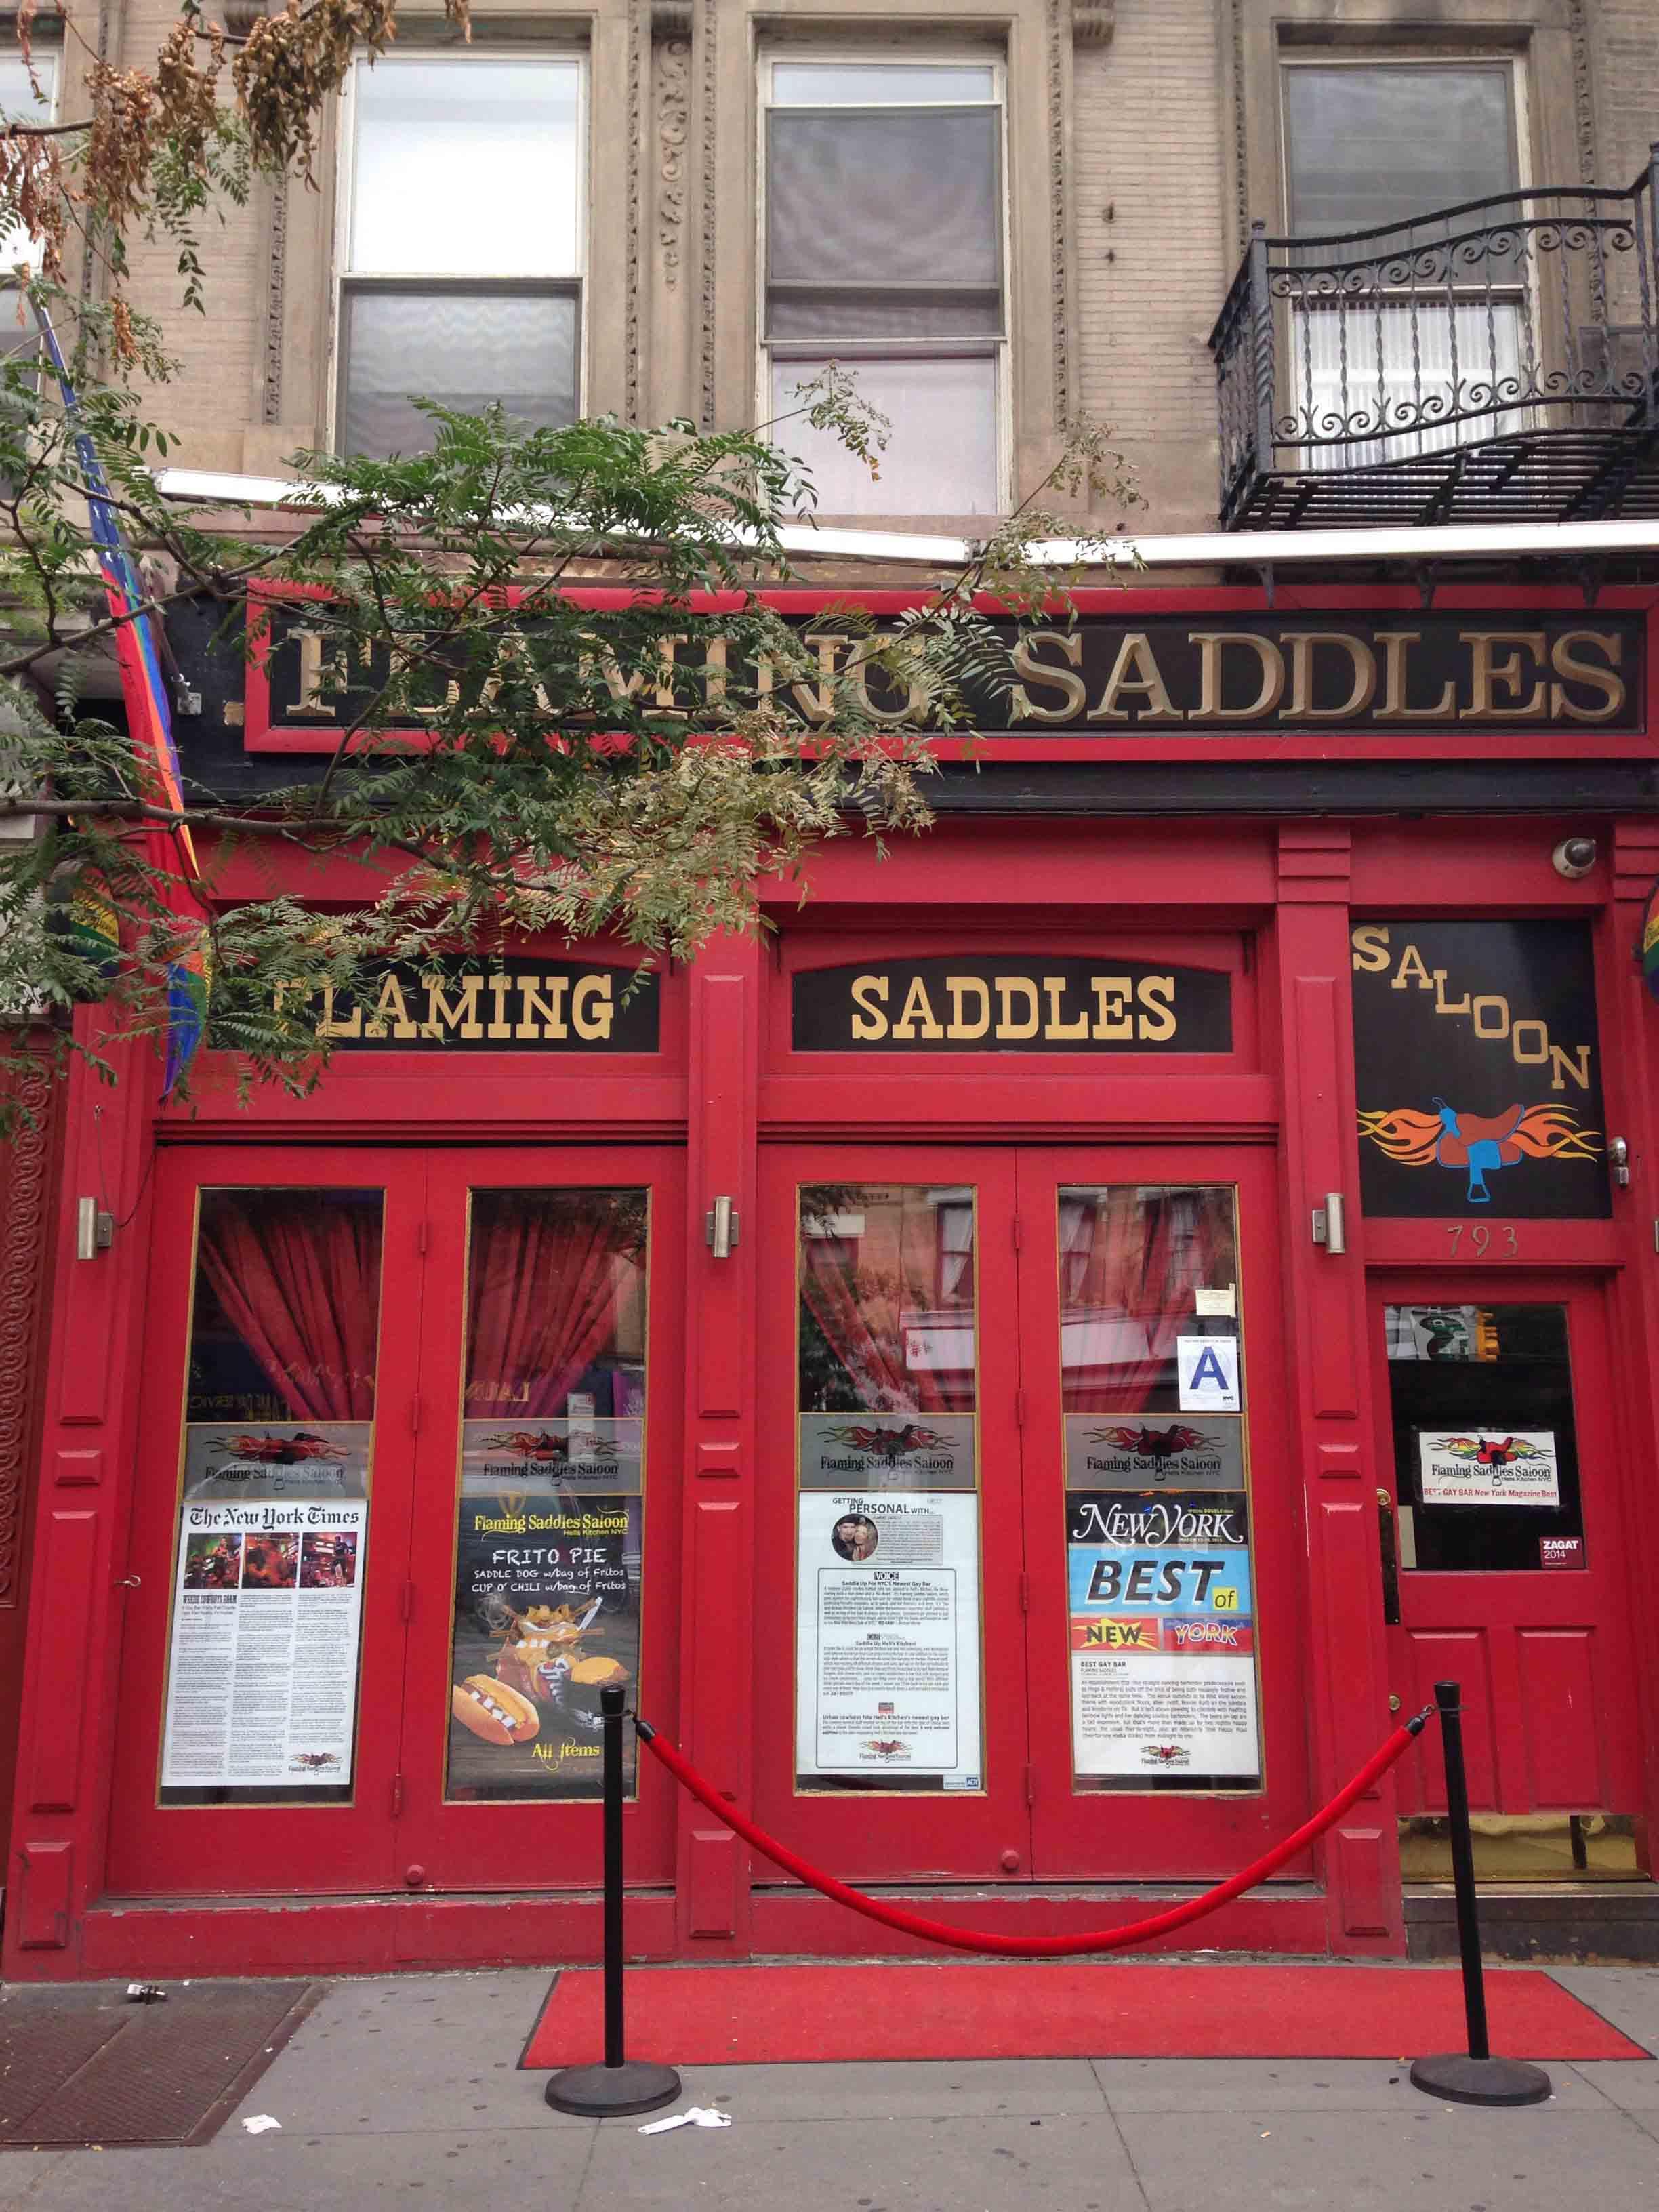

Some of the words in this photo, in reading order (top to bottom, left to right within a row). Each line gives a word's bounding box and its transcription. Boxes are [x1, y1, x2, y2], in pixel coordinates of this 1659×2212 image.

[1010, 630, 1625, 723] SADDLES
[851, 975, 1177, 1042] SADDLES
[1351, 926, 1591, 1090] SALOON
[1446, 1224, 1519, 1258] 793
[1189, 1346, 1229, 1389] A
[483, 1462, 527, 1477] Flaming
[577, 1462, 618, 1475] Saloon
[820, 1456, 865, 1471] Flaming
[914, 1456, 954, 1470] Saloon
[1086, 1456, 1130, 1471] Flaming
[1132, 1456, 1179, 1470] Saddles
[1181, 1456, 1221, 1470] Saloon
[1432, 1463, 1471, 1478] Flaming
[1473, 1464, 1515, 1476] Saddles
[1515, 1465, 1551, 1477] Saloon
[832, 1497, 864, 1505] GETTING
[1443, 1488, 1456, 1496] GAY
[1459, 1488, 1473, 1496] BAR
[1475, 1488, 1490, 1496] New
[1491, 1489, 1507, 1497] York
[1508, 1490, 1540, 1498] Magazine
[849, 1503, 910, 1514] PERSONAL
[189, 1507, 222, 1528] The
[223, 1507, 259, 1527] New
[262, 1507, 304, 1530] York
[307, 1506, 359, 1525] Times
[475, 1514, 525, 1534] Flaming
[528, 1513, 581, 1530] Saddles
[582, 1513, 630, 1530] Saloon
[1543, 1540, 1578, 1549] ZAGAT
[493, 1549, 560, 1566] FRITO
[569, 1547, 607, 1565] PIE
[1544, 1550, 1566, 1559] 2014
[474, 1569, 512, 1578] SADDLE
[516, 1569, 539, 1578] DOG
[543, 1568, 573, 1580] w/bag
[577, 1567, 590, 1579] of
[594, 1568, 624, 1576] Fritos
[875, 1572, 900, 1580] VOICE
[472, 1583, 493, 1593] CUP
[510, 1582, 541, 1592] CHILI
[545, 1581, 577, 1593] w/bag
[579, 1580, 592, 1593] of
[595, 1581, 627, 1590] Fritos
[1084, 1560, 1225, 1605] BEST
[1214, 1590, 1235, 1608] of
[1086, 1626, 1142, 1643] NEW
[1174, 1622, 1238, 1645] YORK
[531, 1743, 555, 1762] All
[560, 1743, 601, 1761] Items
